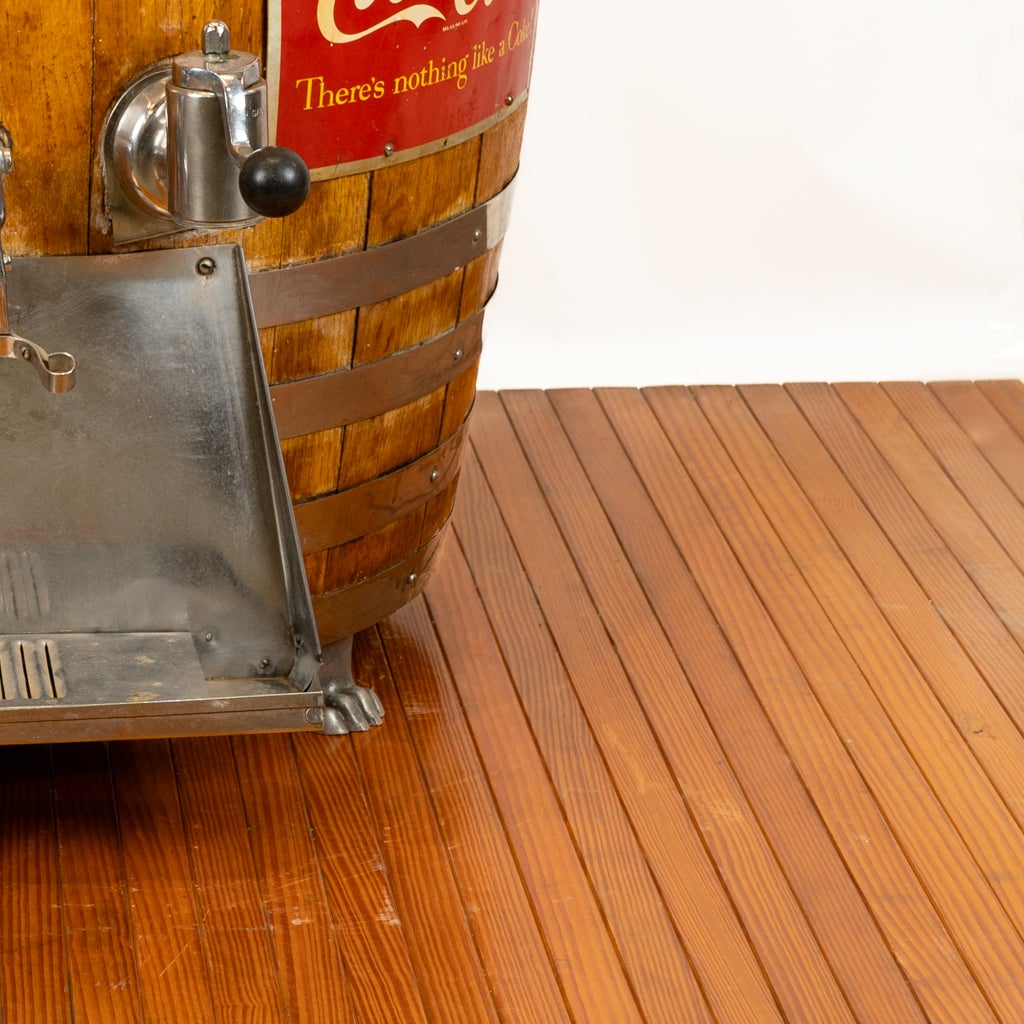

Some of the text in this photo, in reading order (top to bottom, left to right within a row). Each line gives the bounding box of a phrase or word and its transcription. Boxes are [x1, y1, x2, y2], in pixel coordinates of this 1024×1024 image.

[296, 76, 385, 111] There's
[392, 54, 469, 94] nothing
[472, 40, 495, 70] like
[498, 40, 505, 57] a
